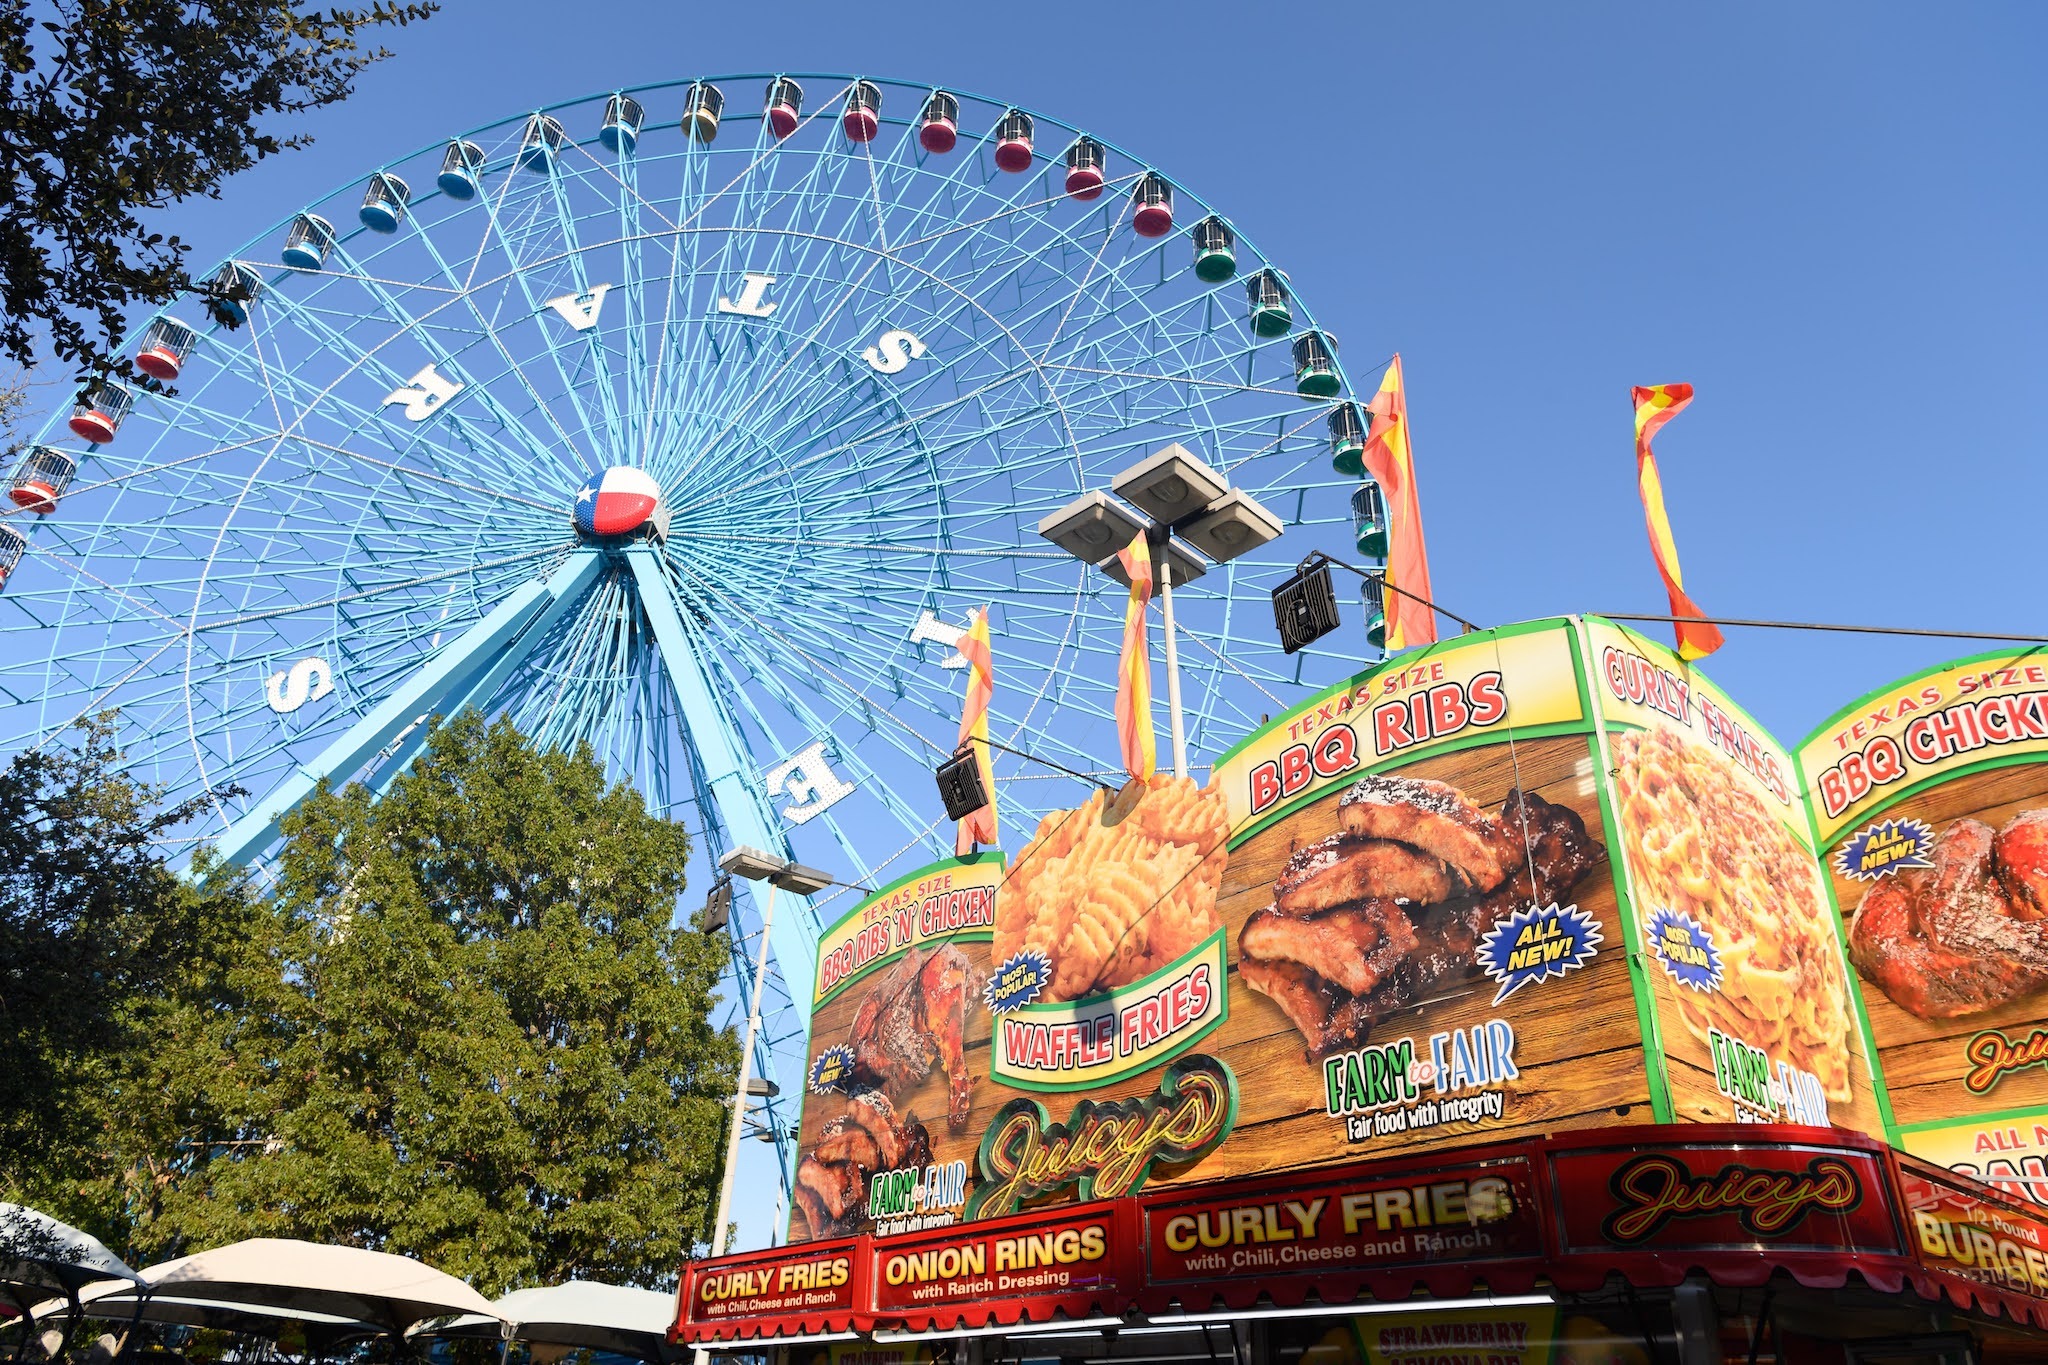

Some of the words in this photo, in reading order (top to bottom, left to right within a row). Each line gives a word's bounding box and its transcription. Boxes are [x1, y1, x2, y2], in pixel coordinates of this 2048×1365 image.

[1287, 686, 1372, 742] TEXAS
[1382, 661, 1445, 696] SIZE
[1833, 686, 1942, 751] TEXAS
[1957, 665, 2047, 696] SIZE
[1250, 723, 1360, 816] BBQ
[1373, 671, 1510, 756] RIBS
[1603, 646, 1692, 728] CURLY
[1698, 692, 1790, 806] FRIES
[1818, 735, 1908, 820] BBQ
[1860, 838, 1916, 873] NEW!
[1864, 826, 1905, 853] ALL
[862, 888, 911, 925] TEXAS
[916, 873, 952, 899] SIZE
[820, 938, 855, 994] BBQ
[856, 917, 890, 970] RIBS
[919, 885, 996, 938] CHICKEN
[1507, 936, 1575, 972] NEW!
[1515, 917, 1563, 947] ALL
[1659, 935, 1711, 972] POPULAR!
[1661, 921, 1692, 947] MOST
[994, 970, 1038, 1002] POPULAR!
[1001, 962, 1029, 987] MOST
[1004, 1013, 1115, 1070] WAFFLE
[1120, 963, 1211, 1057] FRIES
[823, 1053, 842, 1070] ALL
[1324, 1038, 1419, 1118] FARM
[1406, 1060, 1437, 1085] to
[1430, 1020, 1519, 1094] FAIR
[1708, 1027, 1779, 1118] FARM
[1776, 1060, 1831, 1128] FAIR
[1348, 1116, 1374, 1141] Fair
[1374, 1107, 1407, 1137] food
[1407, 1100, 1439, 1129] with
[1440, 1091, 1504, 1123] integrity
[1974, 1127, 2028, 1155] ALL
[869, 1167, 919, 1219] FARM
[923, 1160, 967, 1210] FAIR
[876, 1218, 890, 1237] Fair
[889, 1216, 907, 1235] food
[906, 1213, 923, 1232] with
[922, 1211, 955, 1230] integrity
[1164, 1197, 1328, 1252] CURLY
[1341, 1175, 1518, 1236] FRIES
[1963, 1204, 1990, 1228] 1/2
[1993, 1213, 2041, 1246] Pound
[886, 1243, 985, 1286] ONION
[996, 1225, 1106, 1272] RINGS
[1185, 1252, 1227, 1272] with
[1363, 1235, 1406, 1257] and
[1414, 1228, 1492, 1253] Ranch
[701, 1267, 775, 1303] CURLY
[778, 1257, 850, 1293] FRIES
[912, 1284, 944, 1300] with
[947, 1277, 994, 1296] Ranch
[998, 1270, 1071, 1290] Dressing
[707, 1301, 727, 1316] with
[783, 1293, 802, 1308] and
[804, 1290, 837, 1305] Ranch
[1379, 1321, 1528, 1356] STRAWBERRY
